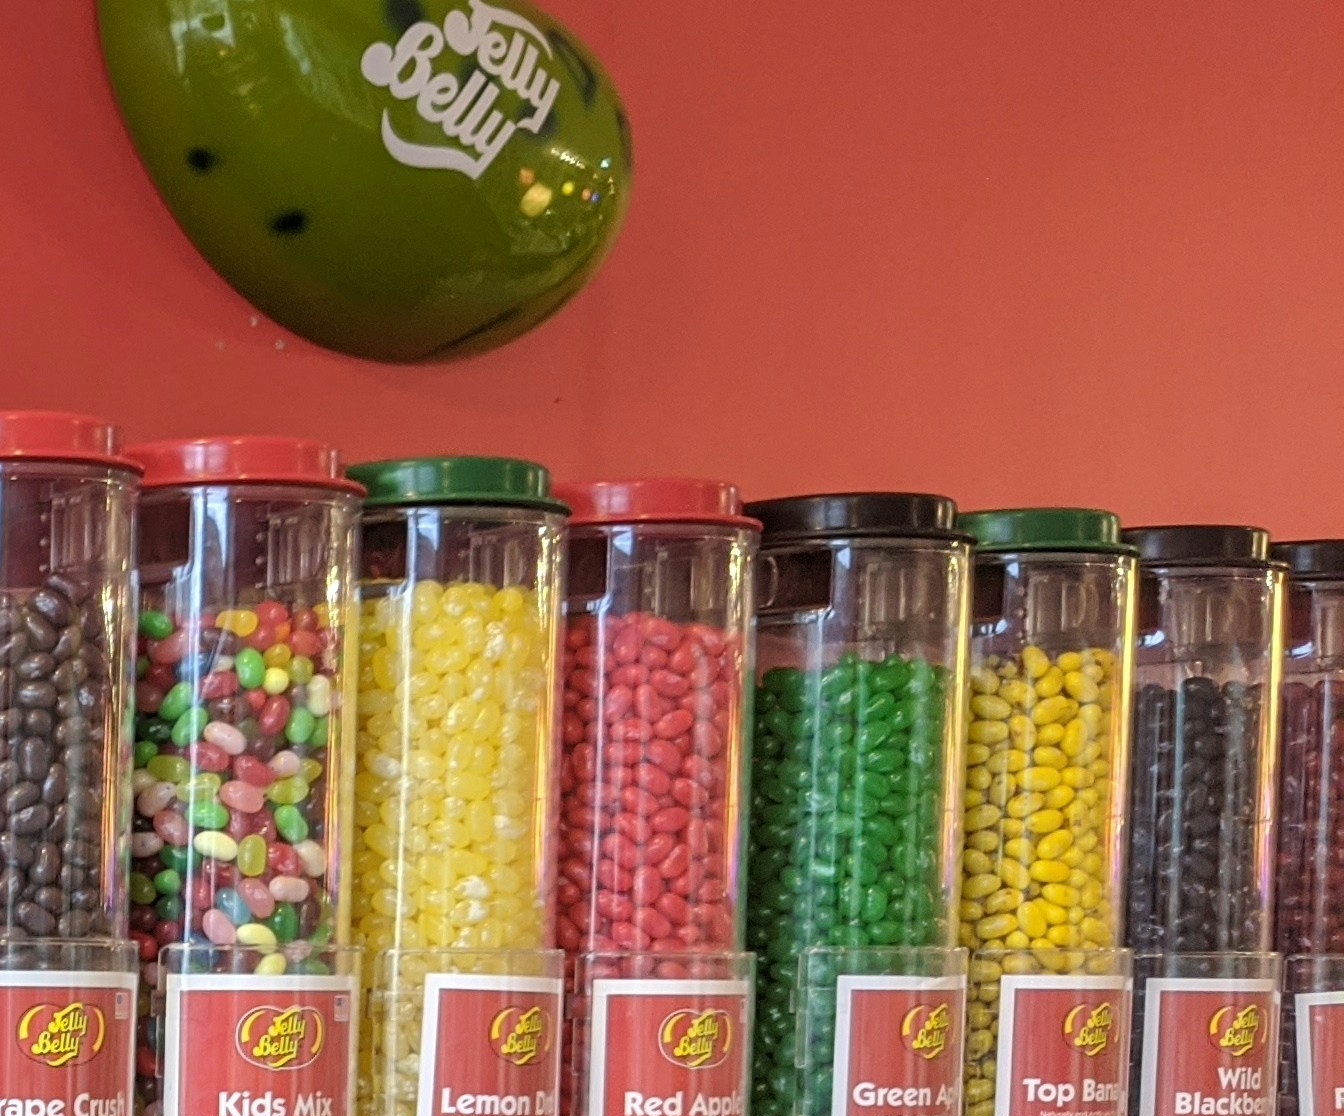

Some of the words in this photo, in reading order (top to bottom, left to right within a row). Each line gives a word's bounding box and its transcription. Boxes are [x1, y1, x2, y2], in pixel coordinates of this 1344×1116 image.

[443, 0, 560, 134] Jelly
[361, 22, 517, 181] Belly
[48, 1002, 87, 1035] Jelly
[268, 1005, 306, 1038] Jelly
[515, 1006, 542, 1035] Jelly
[687, 1009, 719, 1038] Jelly
[31, 1031, 80, 1067] Belly
[253, 1034, 299, 1068] Belly
[501, 1033, 537, 1065] Belly
[674, 1036, 712, 1067] Belly
[912, 1029, 945, 1059] Belly
[1075, 1025, 1107, 1056] Belly
[1219, 1027, 1254, 1057] Belly
[1022, 1078, 1075, 1107] Top
[1217, 1067, 1262, 1090] Wild
[440, 1087, 530, 1115] Lemon
[623, 1090, 684, 1116] Red
[852, 1082, 931, 1107] Green
